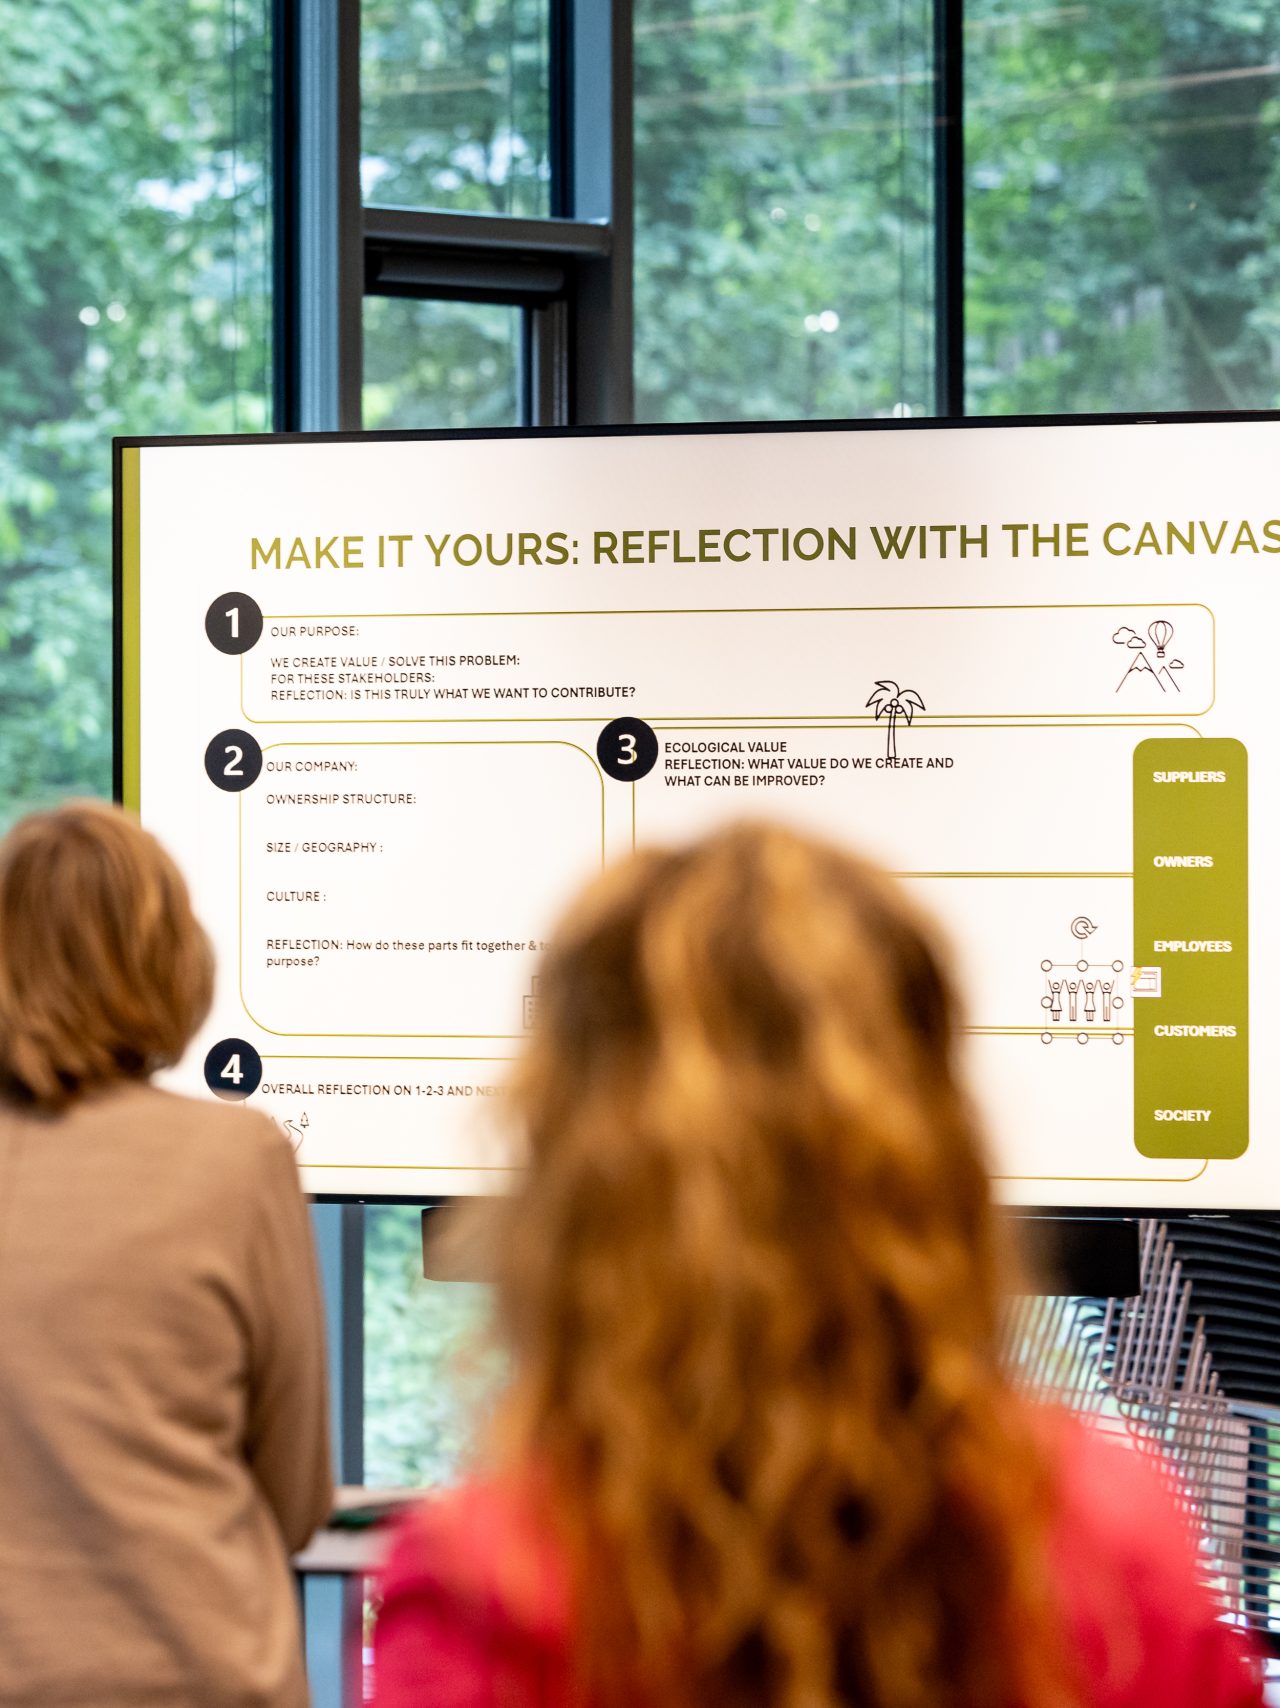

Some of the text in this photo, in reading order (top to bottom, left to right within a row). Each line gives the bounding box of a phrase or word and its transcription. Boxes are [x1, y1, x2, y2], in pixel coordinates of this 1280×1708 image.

[250, 518, 1280, 571] MAKE IT YOURS: REFLECTION WITH THE CANVAS
[225, 607, 239, 638] 1
[270, 625, 360, 638] OUR PURPOSE:
[270, 657, 290, 669] WE
[292, 656, 337, 668] CREATE
[339, 656, 378, 668] VALUE
[388, 655, 426, 667] SOLVE
[428, 655, 457, 667] THIS
[459, 654, 521, 667] PROBLEM:
[271, 672, 435, 685] FOR THESE STAKEHOLDERS:
[271, 686, 637, 701] REFLECTION: IS THIS TRULY WHAT WE WANT TO CONTRIBUTE?
[617, 733, 638, 765] 3
[664, 741, 788, 754] ECOLOGICAL VALUE
[223, 745, 244, 776] 2
[265, 760, 358, 773] OUR COMPANY:
[664, 756, 954, 770] REFLECTION: WHAT VALUE DO WE CREATE AND
[663, 774, 826, 787] WHAT CAN BE IMPROVED?
[1152, 770, 1227, 784] SUPPLIERS
[266, 793, 417, 805] OWNERSHIP STRUCTURE:
[266, 842, 292, 853] SIZE
[301, 841, 377, 853] GEOGRAPHY
[1152, 855, 1215, 868] OWNERS
[266, 890, 321, 902] CULTURE
[266, 938, 343, 950] REFLECTION:
[346, 939, 373, 951] How
[374, 939, 390, 951] do
[391, 939, 425, 951] these
[427, 940, 459, 953] parts
[460, 939, 474, 951] fit
[475, 939, 527, 953] together
[528, 940, 537, 951] &
[1153, 940, 1233, 953] EMPLOYEES
[266, 955, 320, 969] purpose?
[1153, 1024, 1238, 1038] CUSTOMERS
[220, 1053, 244, 1085] 4
[261, 1083, 315, 1096] OVERALL
[317, 1083, 391, 1096] REFLECTION
[393, 1084, 412, 1096] ON
[415, 1084, 445, 1097] 1-2-3
[446, 1085, 474, 1097] AND
[1153, 1109, 1212, 1122] SOCIETY
